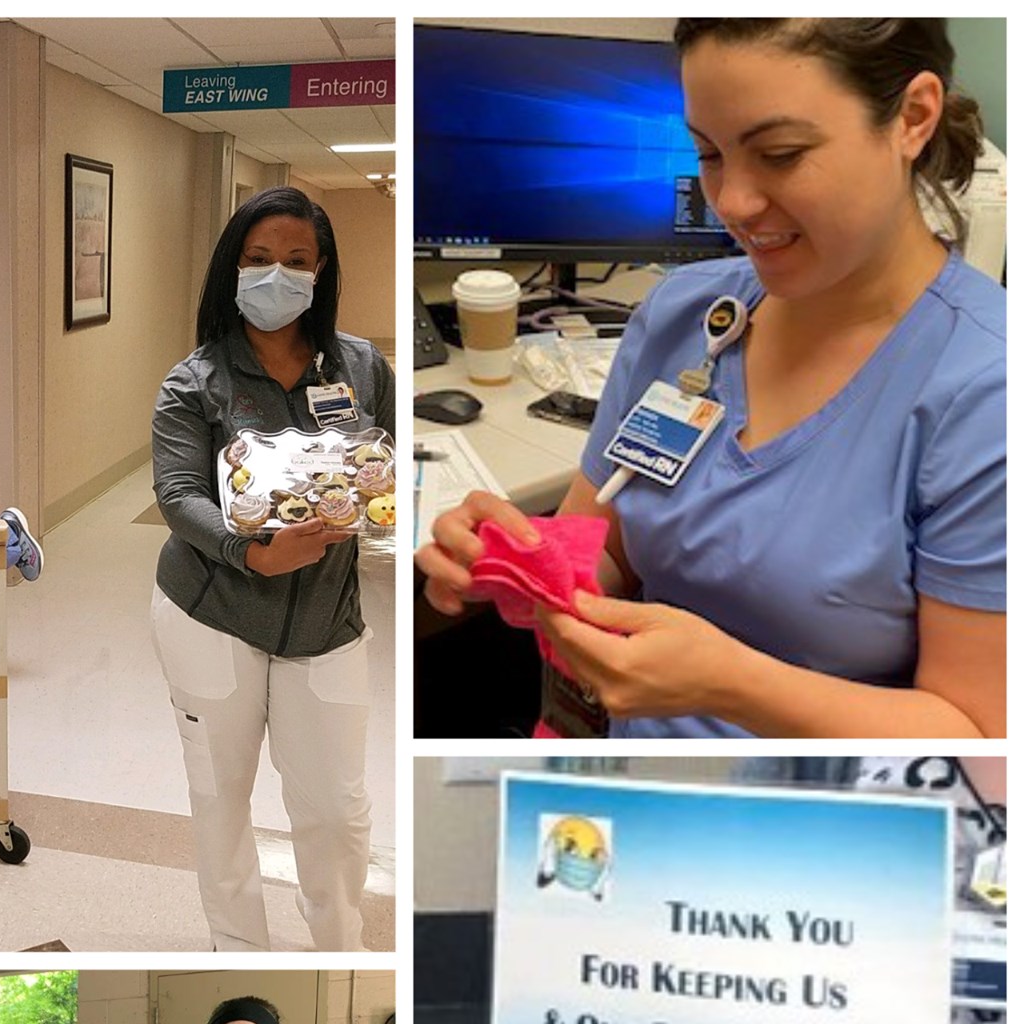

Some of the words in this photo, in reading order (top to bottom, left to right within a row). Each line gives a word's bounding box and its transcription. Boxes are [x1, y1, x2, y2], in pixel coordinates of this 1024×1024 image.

[184, 74, 236, 88] Leaving
[307, 76, 388, 98] Entering
[184, 90, 224, 104] EAST
[228, 87, 269, 102] WING
[654, 455, 679, 477] RN
